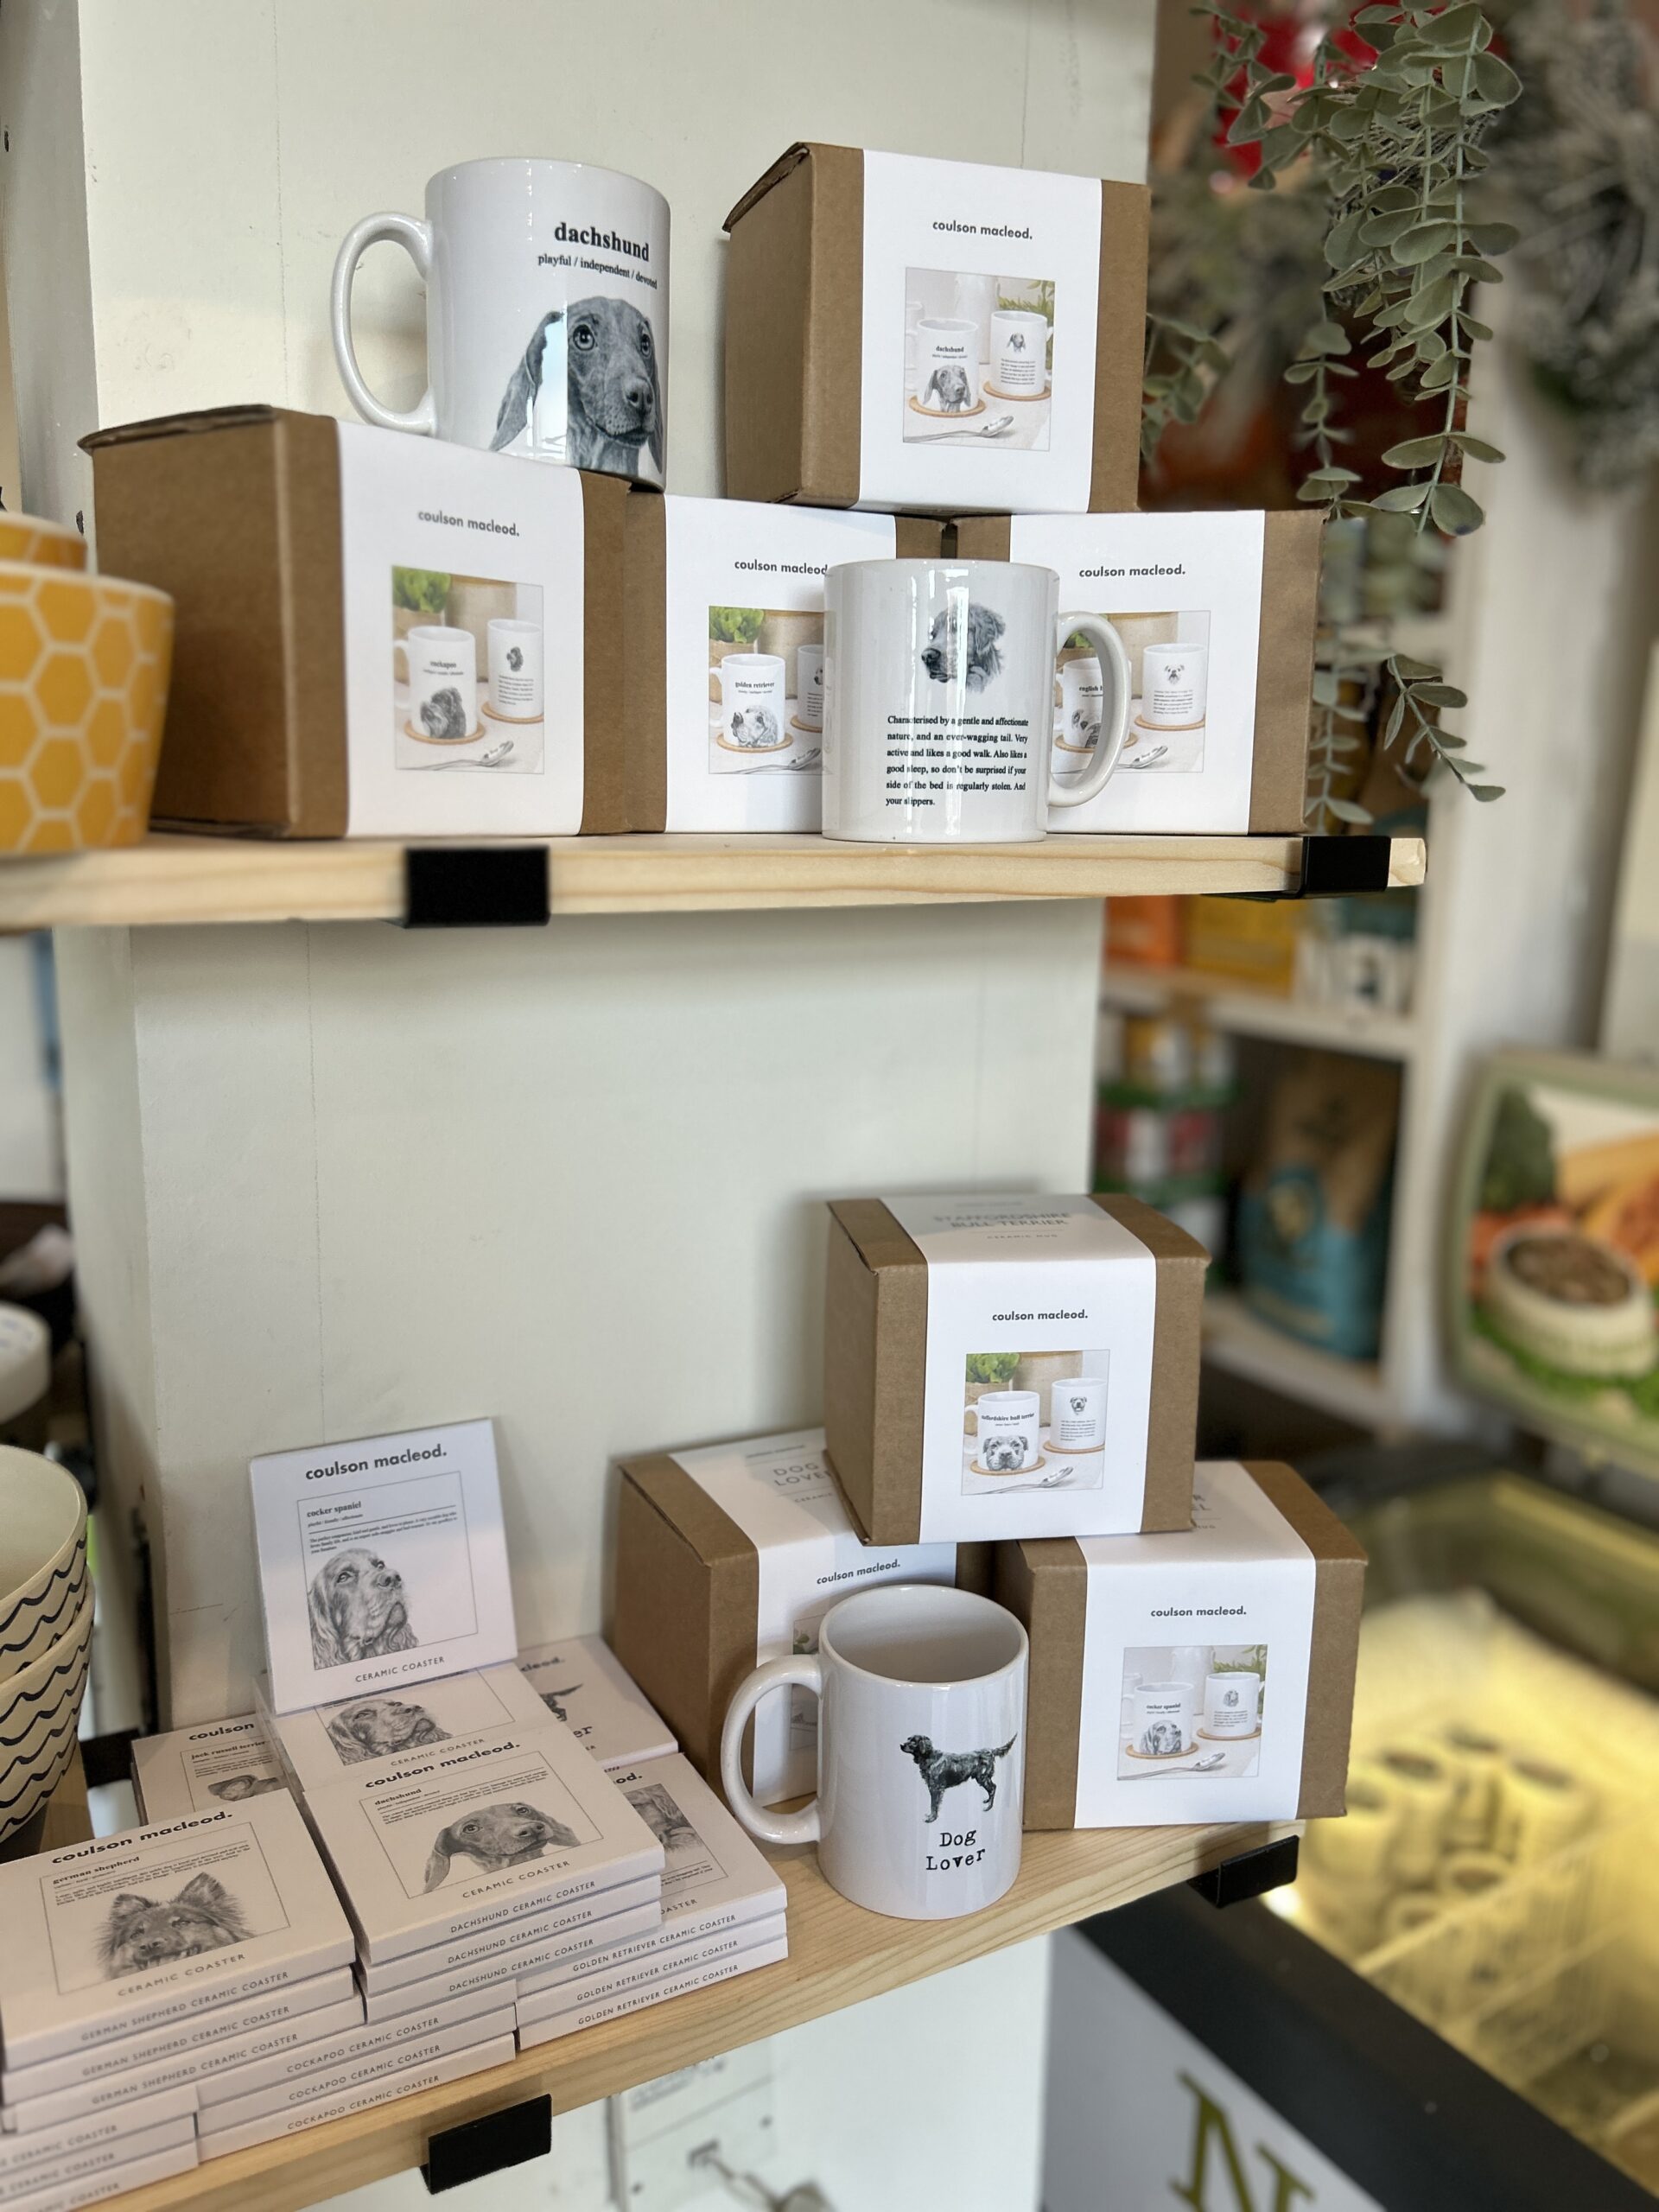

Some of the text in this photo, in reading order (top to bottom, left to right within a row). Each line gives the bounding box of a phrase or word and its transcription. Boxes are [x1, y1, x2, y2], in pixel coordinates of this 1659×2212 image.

[554, 221, 650, 262] dachshund
[932, 220, 1033, 240] coulson macleod.
[537, 253, 571, 267] playful
[581, 257, 630, 279] independent
[635, 270, 658, 289] devoted
[418, 510, 520, 537] coulson macleod.
[734, 559, 777, 572] coulson
[1079, 563, 1186, 578] coulson macleod.
[887, 715, 938, 725] Characterised
[940, 715, 950, 726] by
[957, 716, 980, 726] gentle
[981, 716, 995, 725] and
[995, 716, 1028, 727] affectionate
[887, 734, 914, 742] nature,
[946, 734, 998, 743] ever-wagging
[1000, 734, 1013, 742] tail.
[1015, 734, 1027, 744] Very
[926, 748, 944, 757] likes
[952, 749, 971, 759] good
[973, 749, 992, 758] walk.
[994, 749, 1008, 758] Also
[1010, 750, 1023, 759] likes
[887, 765, 905, 774] good
[907, 765, 928, 774] sleep,
[942, 765, 963, 773] don't
[976, 766, 1006, 775] surprised
[1007, 766, 1013, 774] if
[929, 781, 944, 790] bed
[946, 781, 953, 790] is
[957, 781, 988, 791] regularly
[992, 782, 1012, 791] stolen.
[1014, 782, 1026, 791] And
[904, 797, 935, 807] slippers.
[992, 1309, 1088, 1321] coulson macleod.
[305, 1443, 447, 1480] coulson macleod.
[307, 1501, 361, 1517] cocker spaniel
[816, 1559, 900, 1585] coulson macleod.
[1150, 1605, 1247, 1618] coulson macleod.
[355, 1656, 445, 1683] CERAMIC COASTER
[520, 1656, 565, 1672] cleod.
[188, 1722, 254, 1741] coulson
[191, 1751, 209, 1760] jack
[211, 1745, 238, 1755] russell
[239, 1740, 266, 1749] terrier
[391, 1738, 485, 1767] CERAMIC COASTER
[365, 1741, 520, 1789] coulson macleod.
[375, 1789, 422, 1806] dachshund
[52, 1811, 232, 1864] coulson macleod.
[939, 1829, 976, 1847] Dog
[53, 1870, 92, 1885] german
[94, 1856, 140, 1872] shepherd
[925, 1848, 985, 1871] Lover
[462, 1860, 570, 1899] CERAMIC COASTER
[450, 1880, 595, 1933] DACHSHUND CERAMIC COASTER
[448, 1910, 592, 1963] DACHSHUND CERAMIC COASTER
[573, 1914, 735, 1972] GOLDEN RETRIEVER CERAMIC COASTER
[118, 1954, 245, 1997] CERAMIC COASTER
[449, 1939, 594, 1992] DACHSHUND CERAMIC COASTER
[577, 1940, 738, 2001] GOLDEN RETRIEVER CERAMIC COASTER
[81, 1971, 289, 2041] GERMAN SHEPHERD CERAMIC COASTER
[578, 1964, 738, 2024] GOLDEN RETRIEVER CERAMIC COASTER
[83, 2005, 289, 2075] GERMAN SHEPHERD CERAMIC COASTER
[287, 2018, 439, 2073] COCKAPOO CERAMIC COASTER
[92, 2033, 298, 2105] GERMAN SHEPHERD CERAMIC COASTER
[289, 2044, 441, 2101] COCKAPOO CERAMIC COASTER
[287, 2075, 439, 2130] COCKAPOO CERAMIC COASTER
[67, 2125, 118, 2145] COASTER
